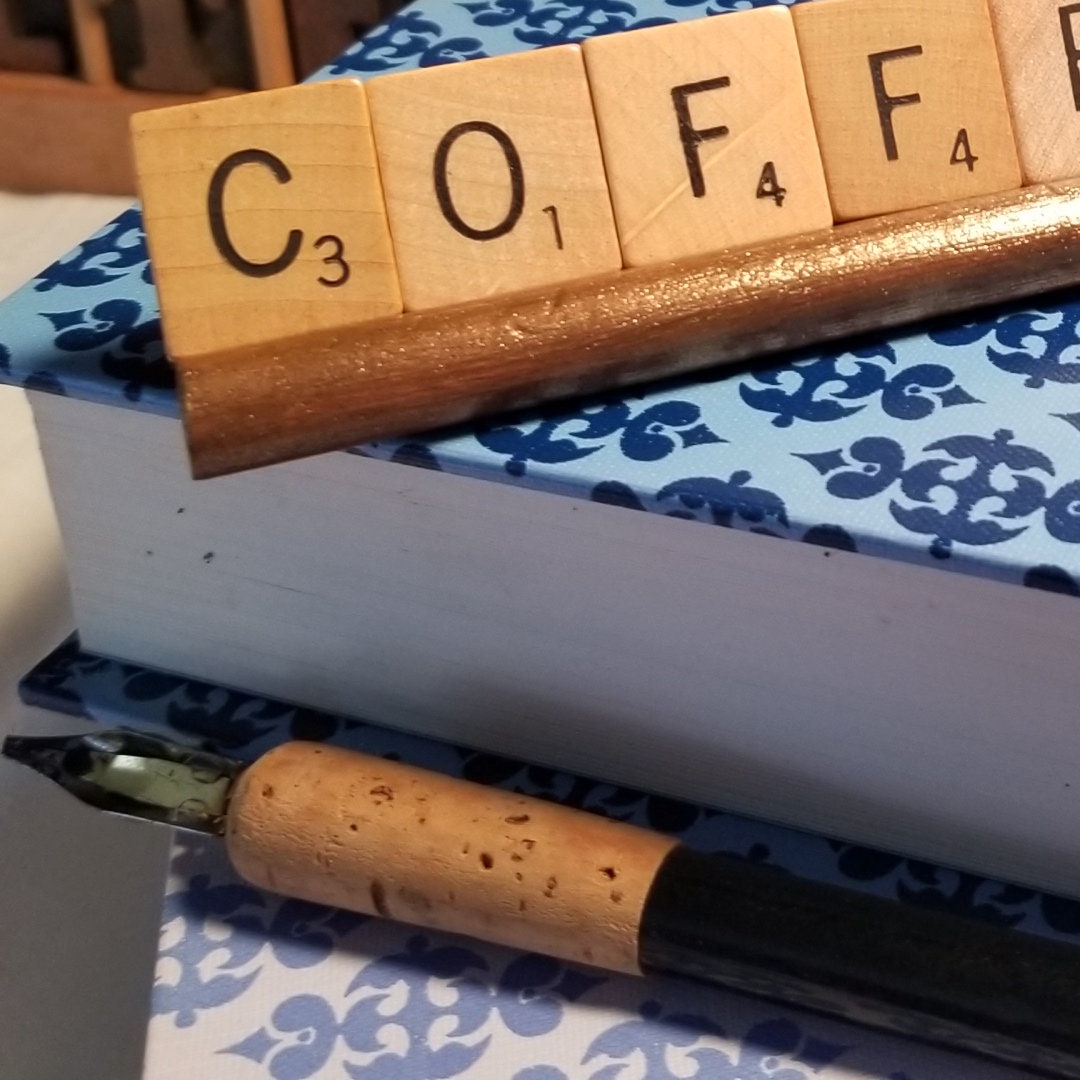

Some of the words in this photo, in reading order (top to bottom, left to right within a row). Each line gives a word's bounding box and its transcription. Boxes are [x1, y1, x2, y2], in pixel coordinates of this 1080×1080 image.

[949, 127, 979, 172] 4
[755, 160, 788, 208] 4
[542, 204, 564, 251] 1
[312, 235, 351, 287] 3
